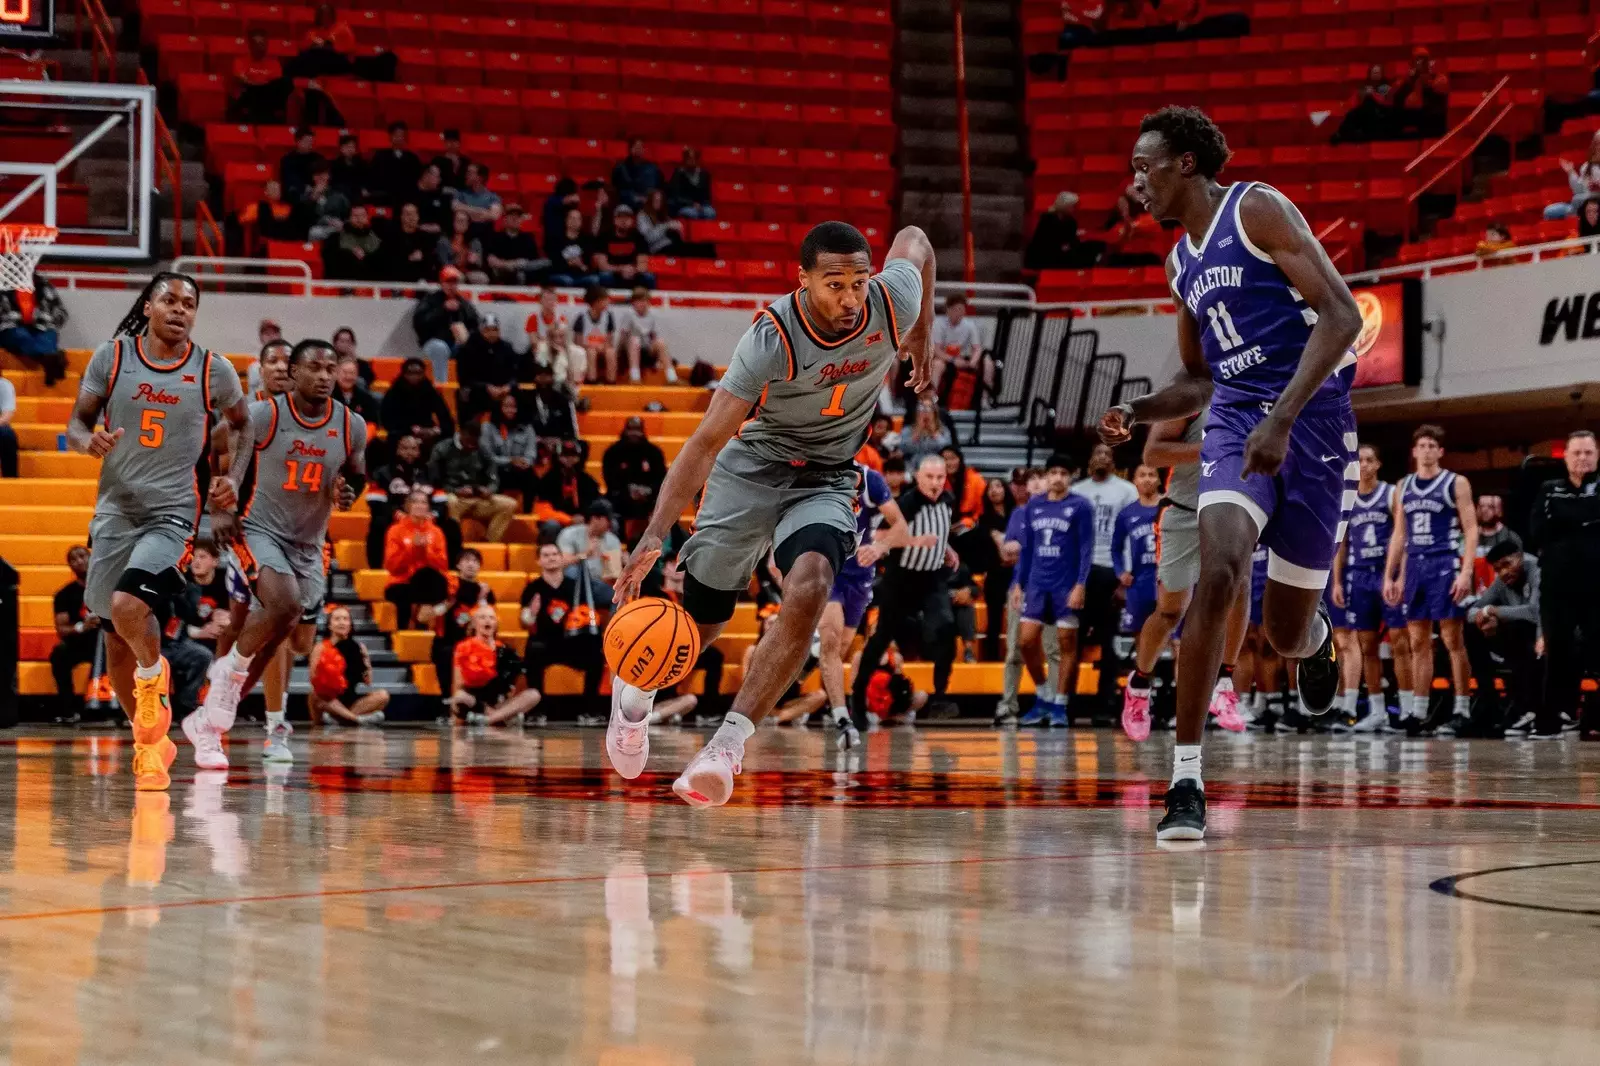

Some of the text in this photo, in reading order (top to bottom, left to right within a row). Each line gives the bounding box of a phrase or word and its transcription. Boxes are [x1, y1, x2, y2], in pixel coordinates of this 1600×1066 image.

[1186, 265, 1244, 315] TARLETON
[1207, 300, 1245, 352] 11
[813, 359, 871, 386] Pokes
[1219, 345, 1268, 381] STATE
[131, 383, 183, 405] Pokes
[820, 383, 849, 417] 1
[138, 408, 167, 449] 5
[282, 459, 324, 492] 14
[1363, 524, 1377, 546] 4
[1412, 512, 1431, 534] 21
